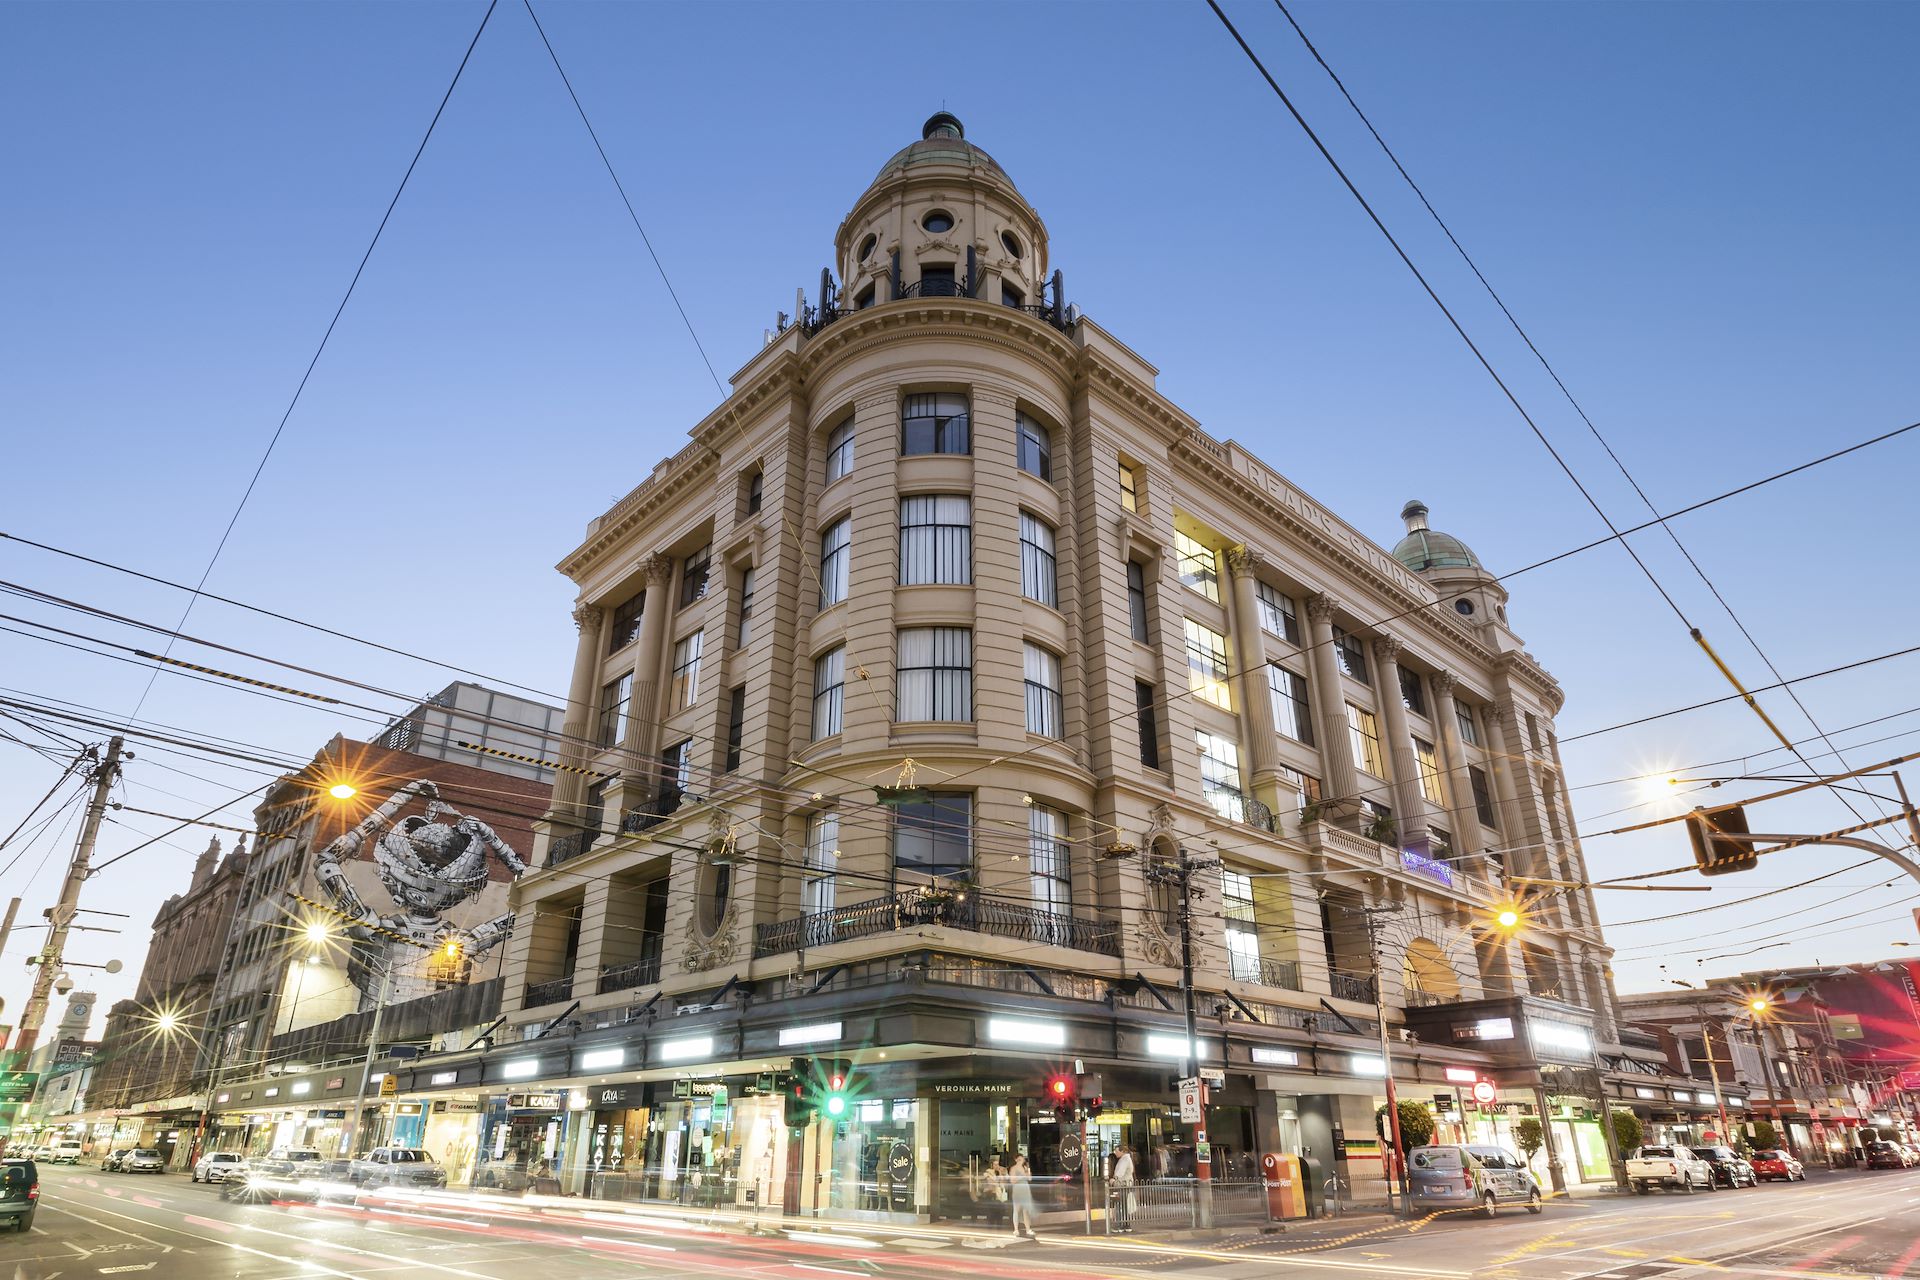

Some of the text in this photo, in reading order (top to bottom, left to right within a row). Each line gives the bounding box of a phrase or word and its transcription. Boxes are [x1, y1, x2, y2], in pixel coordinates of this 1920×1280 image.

[1350, 535, 1428, 602] STORES
[530, 1096, 555, 1107] KAYA
[602, 1090, 618, 1101] KAYA
[1063, 1145, 1079, 1159] Sale
[892, 1156, 909, 1169] Sale
